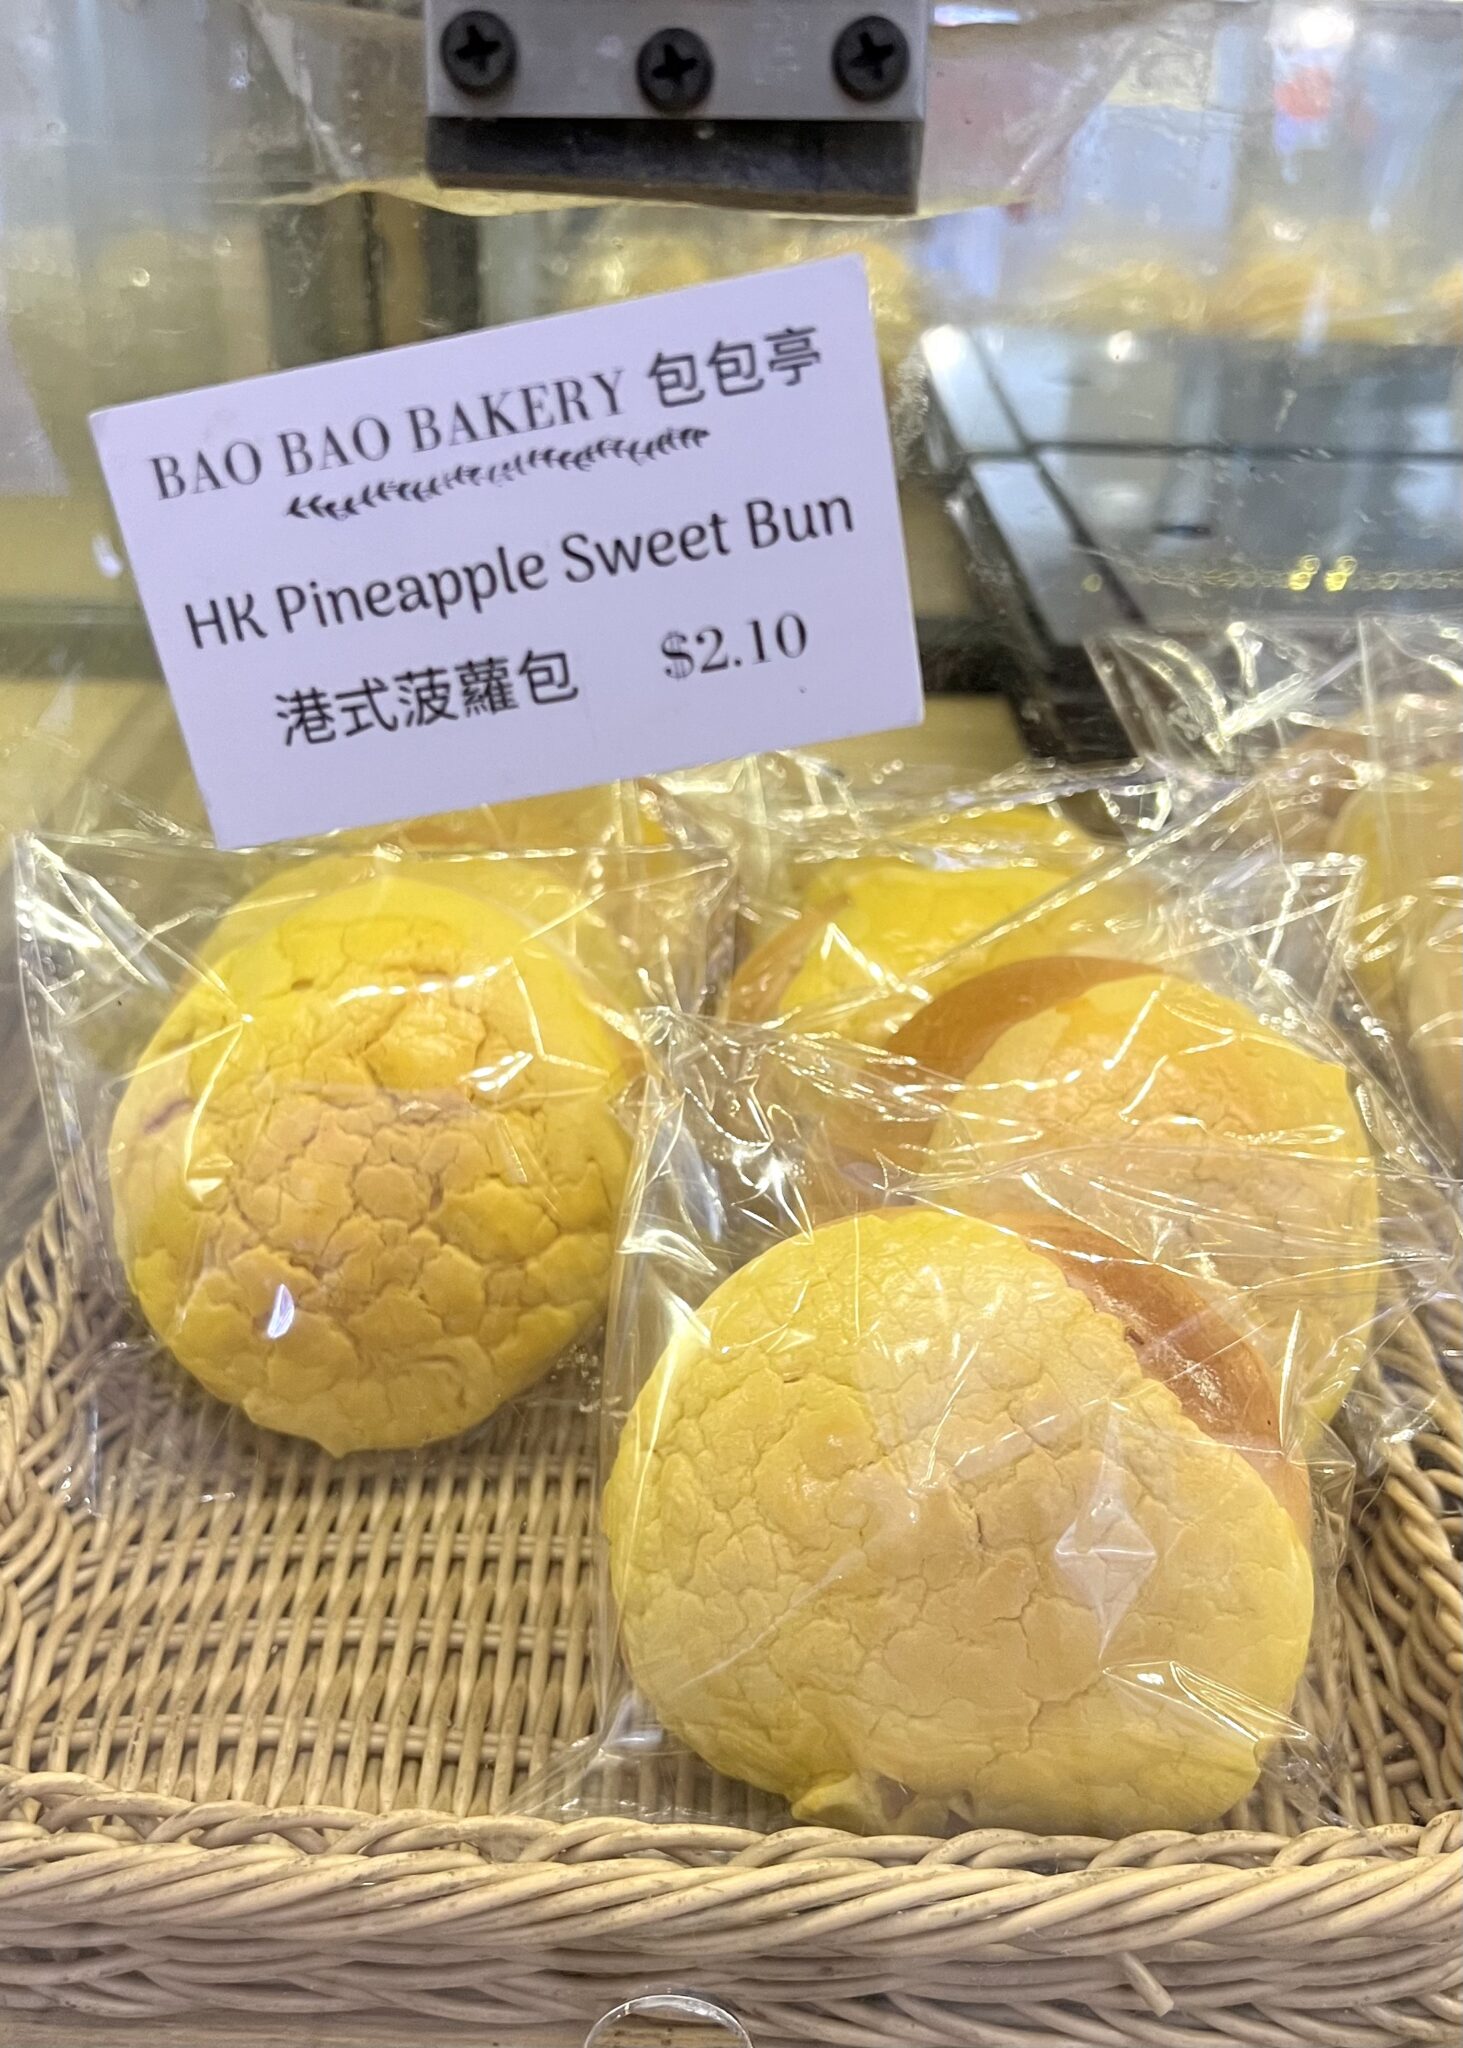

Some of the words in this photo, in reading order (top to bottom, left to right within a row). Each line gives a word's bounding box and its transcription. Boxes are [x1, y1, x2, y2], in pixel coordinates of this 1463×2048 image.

[149, 440, 263, 501] BAO
[276, 416, 391, 477] BAO
[405, 369, 624, 453] BAKERY
[646, 326, 821, 409] 包包亭
[184, 592, 269, 650] HK
[274, 545, 549, 634] Pineapple
[560, 511, 732, 583] Sweet
[744, 494, 854, 550] Bun
[274, 649, 580, 747] 港式菠蘿包
[660, 612, 808, 680] $2.10
